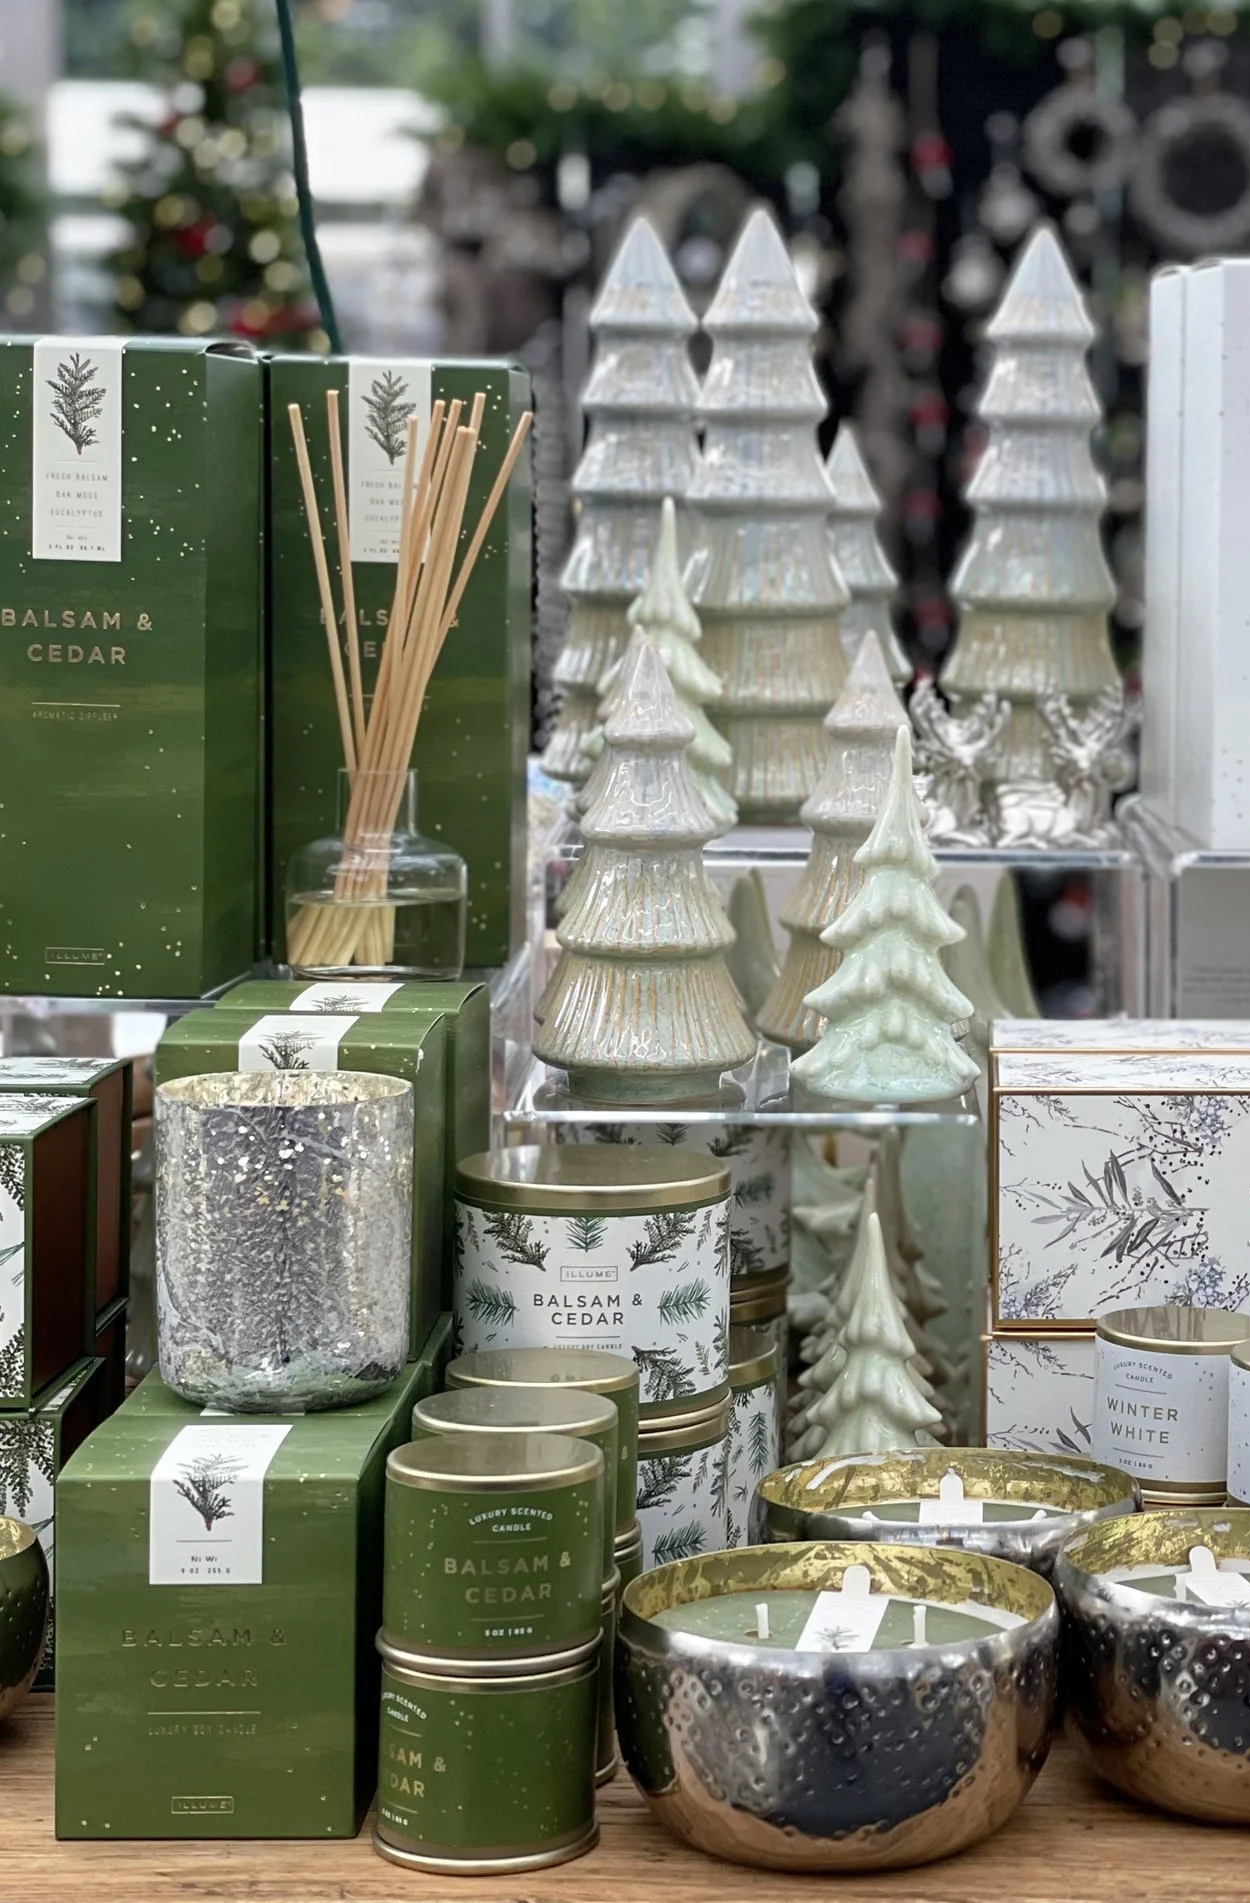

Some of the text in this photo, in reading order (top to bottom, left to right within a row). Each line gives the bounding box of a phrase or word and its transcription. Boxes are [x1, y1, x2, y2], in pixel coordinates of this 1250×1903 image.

[1, 608, 153, 631] BALSAM &
[27, 643, 126, 665] CEDAR
[566, 1270, 612, 1278] ILLUME
[533, 1293, 643, 1308] BALSAM &
[551, 1312, 624, 1326] CEDAR
[1113, 1360, 1173, 1380] LUXURY SCENTED
[1125, 1373, 1154, 1384] CANDLE
[1107, 1396, 1178, 1422] WINTER
[1111, 1421, 1170, 1445] WHITE
[468, 1507, 553, 1526] LUXURY SCENTED
[492, 1523, 532, 1533] CANDLE
[444, 1551, 571, 1575] BALSAM &
[464, 1583, 552, 1604] CEDAR
[122, 1627, 286, 1647] BALSAM &
[150, 1669, 258, 1688] CEDAR
[396, 1695, 427, 1720] SCENTED
[433, 1756, 447, 1773] &
